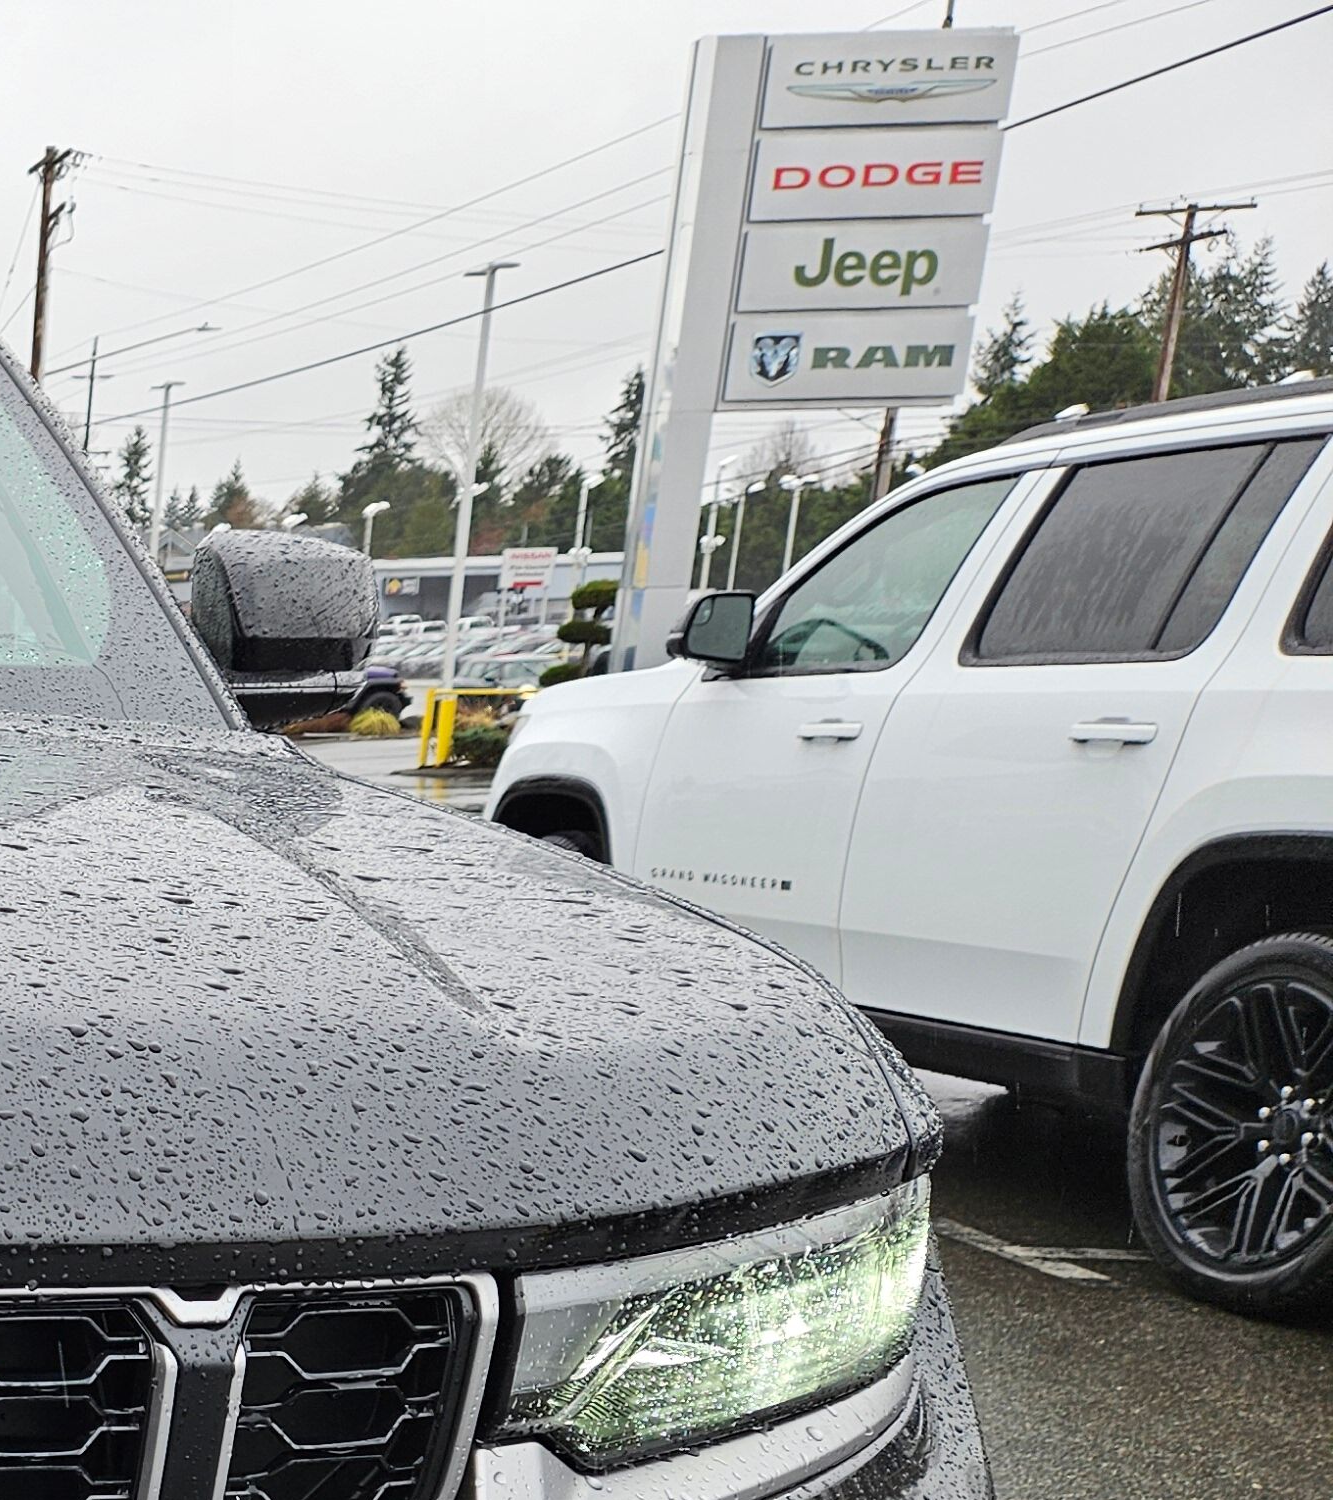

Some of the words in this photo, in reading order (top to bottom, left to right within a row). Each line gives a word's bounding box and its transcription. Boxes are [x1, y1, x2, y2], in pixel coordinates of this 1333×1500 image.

[794, 55, 996, 76] CHRYSLER
[771, 160, 985, 191] DODGE
[793, 237, 939, 297] Jeep
[810, 343, 956, 370] RAM
